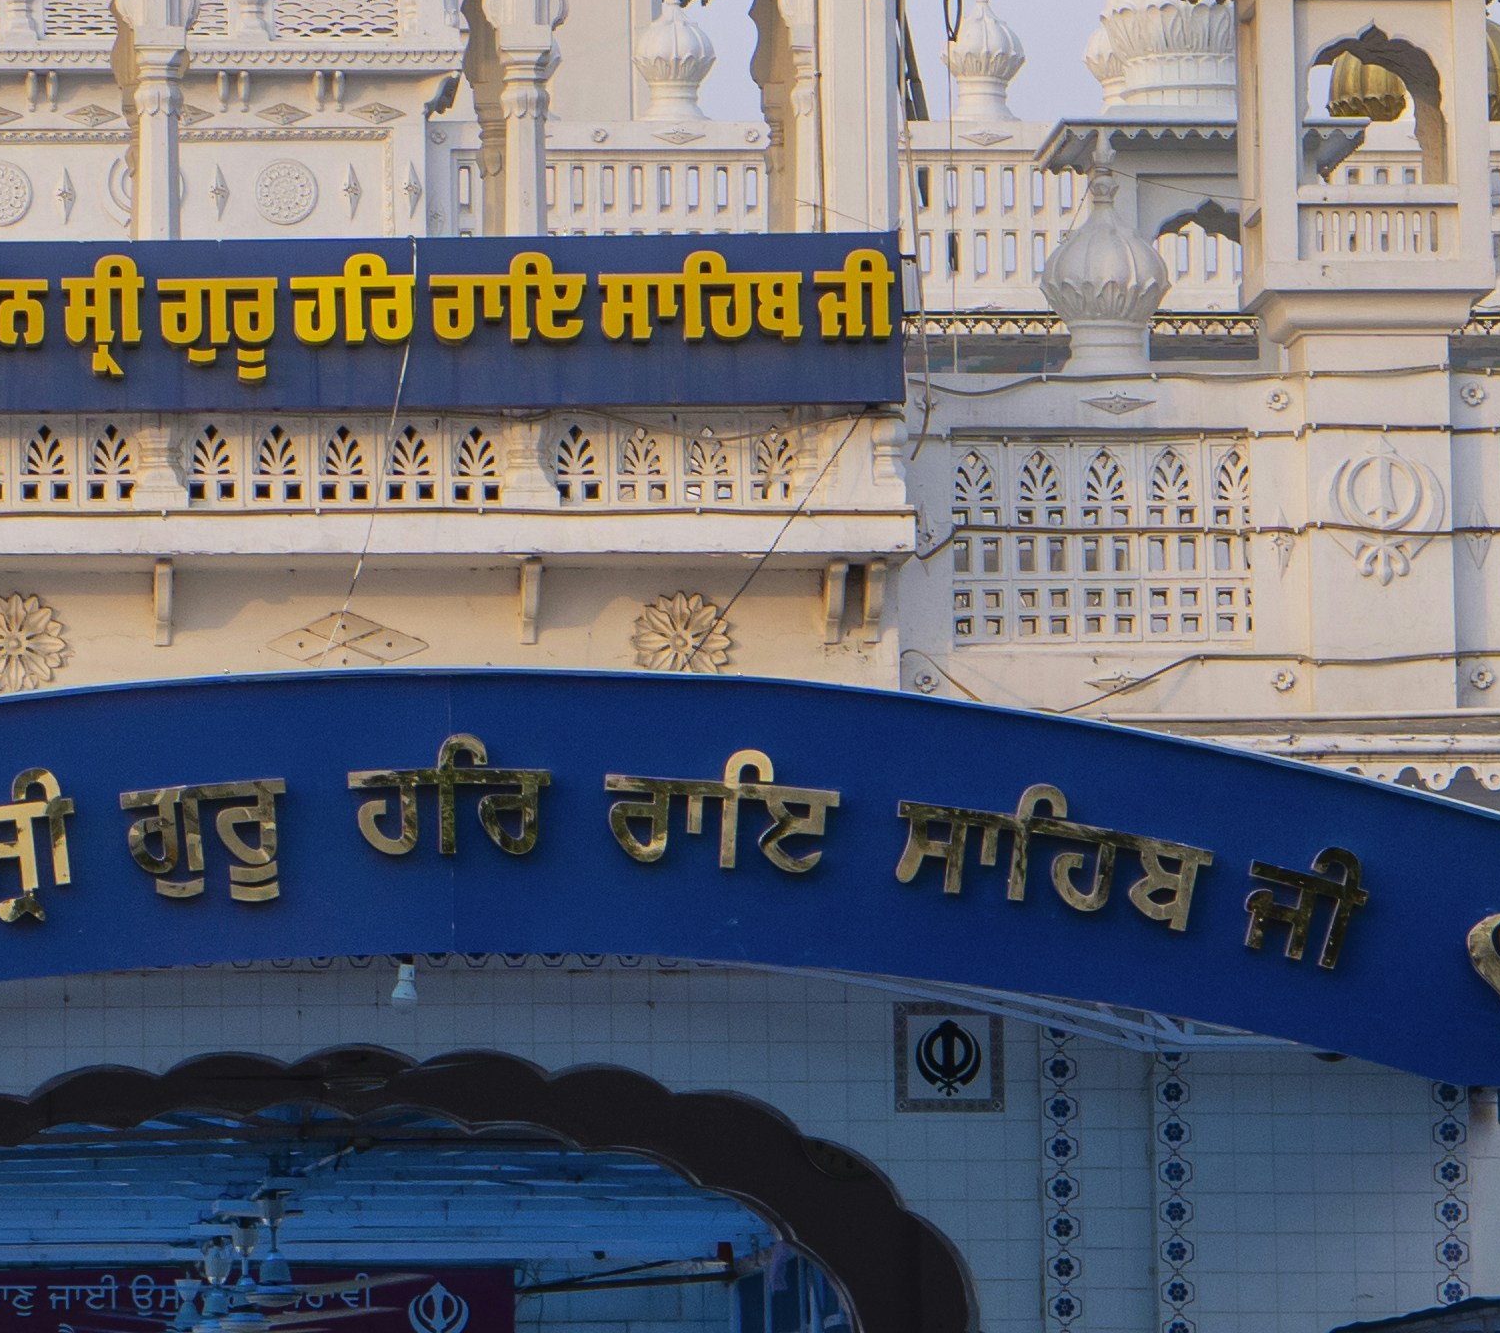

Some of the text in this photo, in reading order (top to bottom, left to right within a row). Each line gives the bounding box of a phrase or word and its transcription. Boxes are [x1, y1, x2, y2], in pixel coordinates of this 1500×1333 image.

[60, 254, 145, 376] ਸ੍ਰੀ
[156, 276, 279, 382] ਗੁਰੂ
[289, 252, 415, 344] ਹਰਿ
[428, 251, 587, 343] ਰਾਇ
[597, 250, 803, 341] ਸਾਹਿਬ
[813, 248, 895, 339] ਜੀ
[119, 778, 286, 903] ਗੁਰੂ
[347, 734, 552, 857] ਹਰਿ
[603, 749, 841, 874] ਰਾਇ
[895, 783, 1215, 933] ਸਾਹਿਬ
[1244, 847, 1369, 971] ਜੀ
